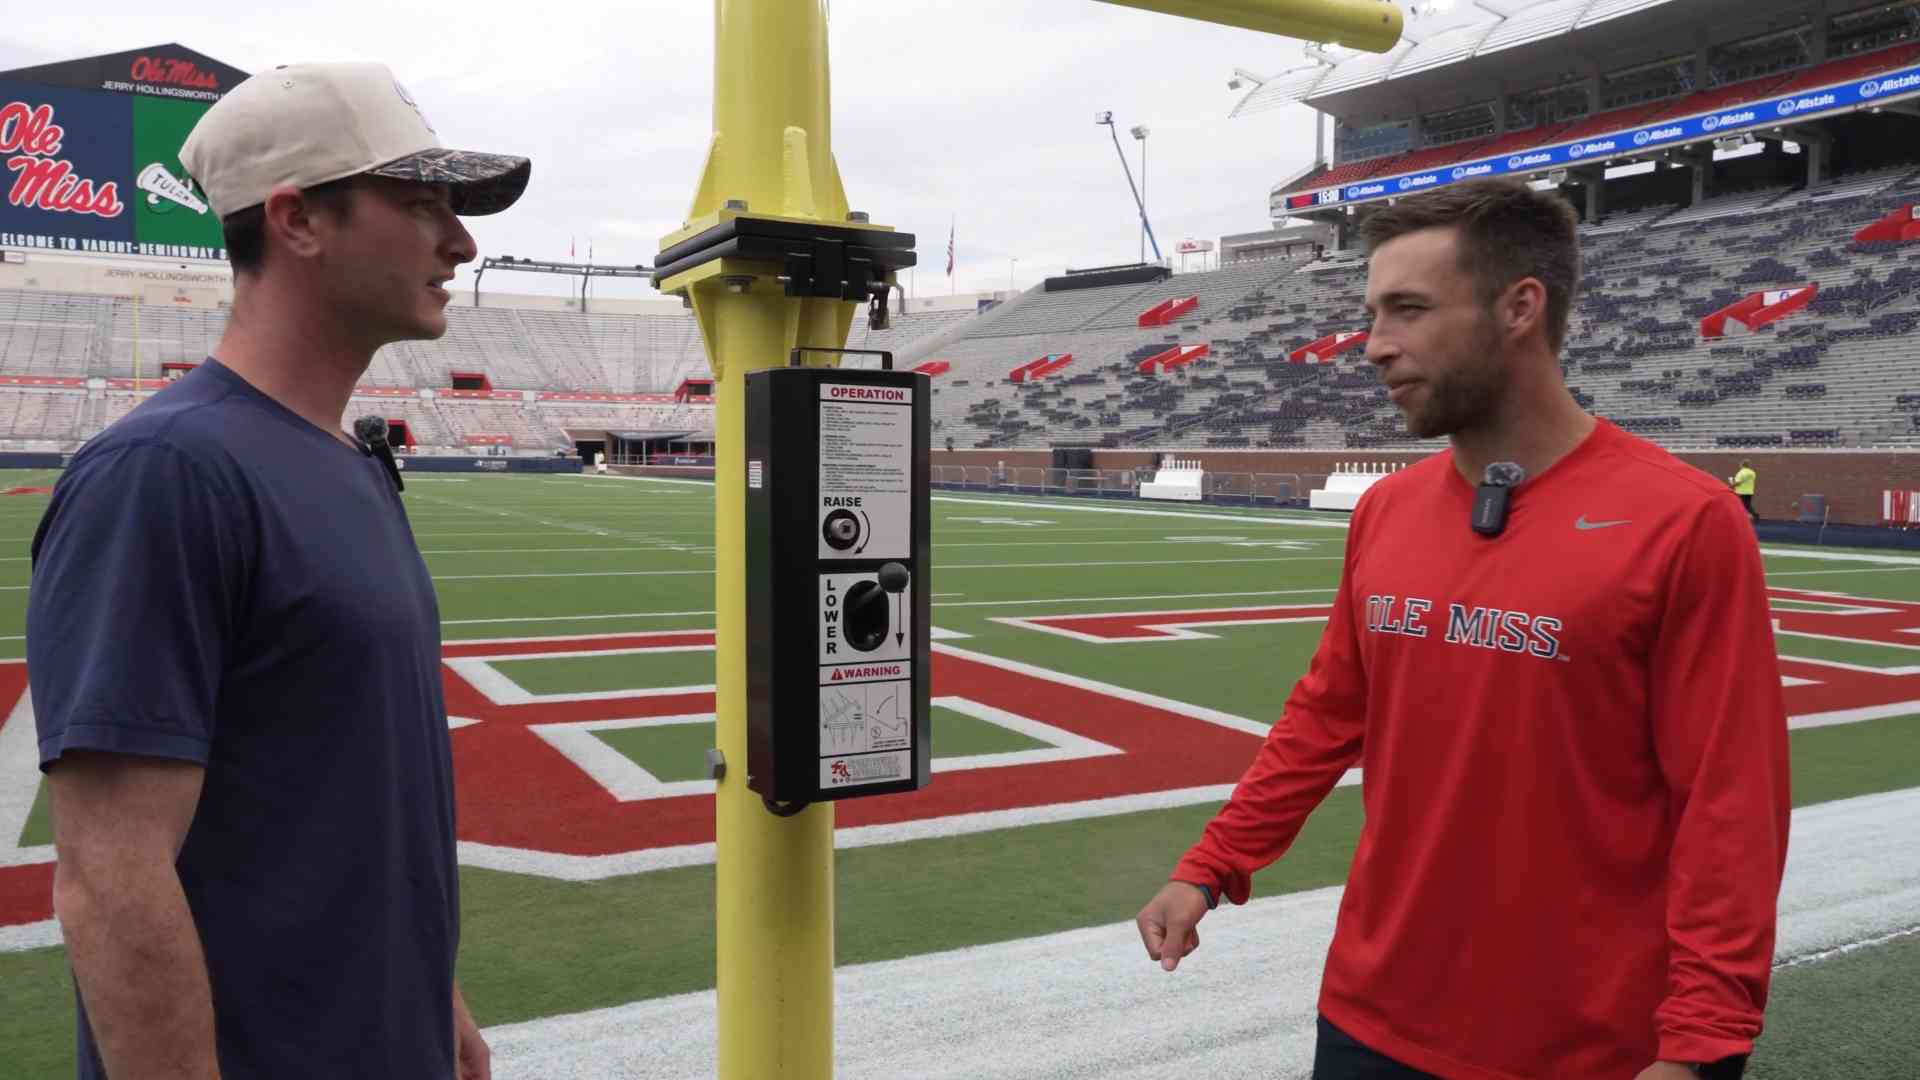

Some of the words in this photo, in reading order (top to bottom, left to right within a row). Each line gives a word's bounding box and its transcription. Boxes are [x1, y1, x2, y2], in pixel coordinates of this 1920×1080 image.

[130, 56, 164, 82] Ole
[164, 58, 219, 89] Miss
[102, 80, 134, 91] JERRY
[136, 84, 219, 100] HOLLINGSWORTH
[1878, 72, 1920, 93] Allstate
[1795, 94, 1835, 111] Allstate
[1718, 111, 1755, 127] Allstate
[0, 101, 64, 156] Ole
[1648, 126, 1682, 141] Allstate
[1583, 141, 1615, 154] Allstate
[7, 155, 124, 218] Miss
[0, 233, 55, 249] ELCOME
[59, 237, 76, 250] TO
[82, 238, 214, 260] VAUGHT-HEMINGWAY
[104, 268, 134, 280] JERRY
[138, 270, 227, 284] HOLLINGSWORTH
[831, 387, 904, 401] OPERATION
[823, 496, 862, 508] RAISE
[824, 579, 839, 655] LOWER
[1366, 595, 1433, 638] OLE
[1444, 603, 1563, 660] MISS
[844, 665, 902, 679] WARNING
